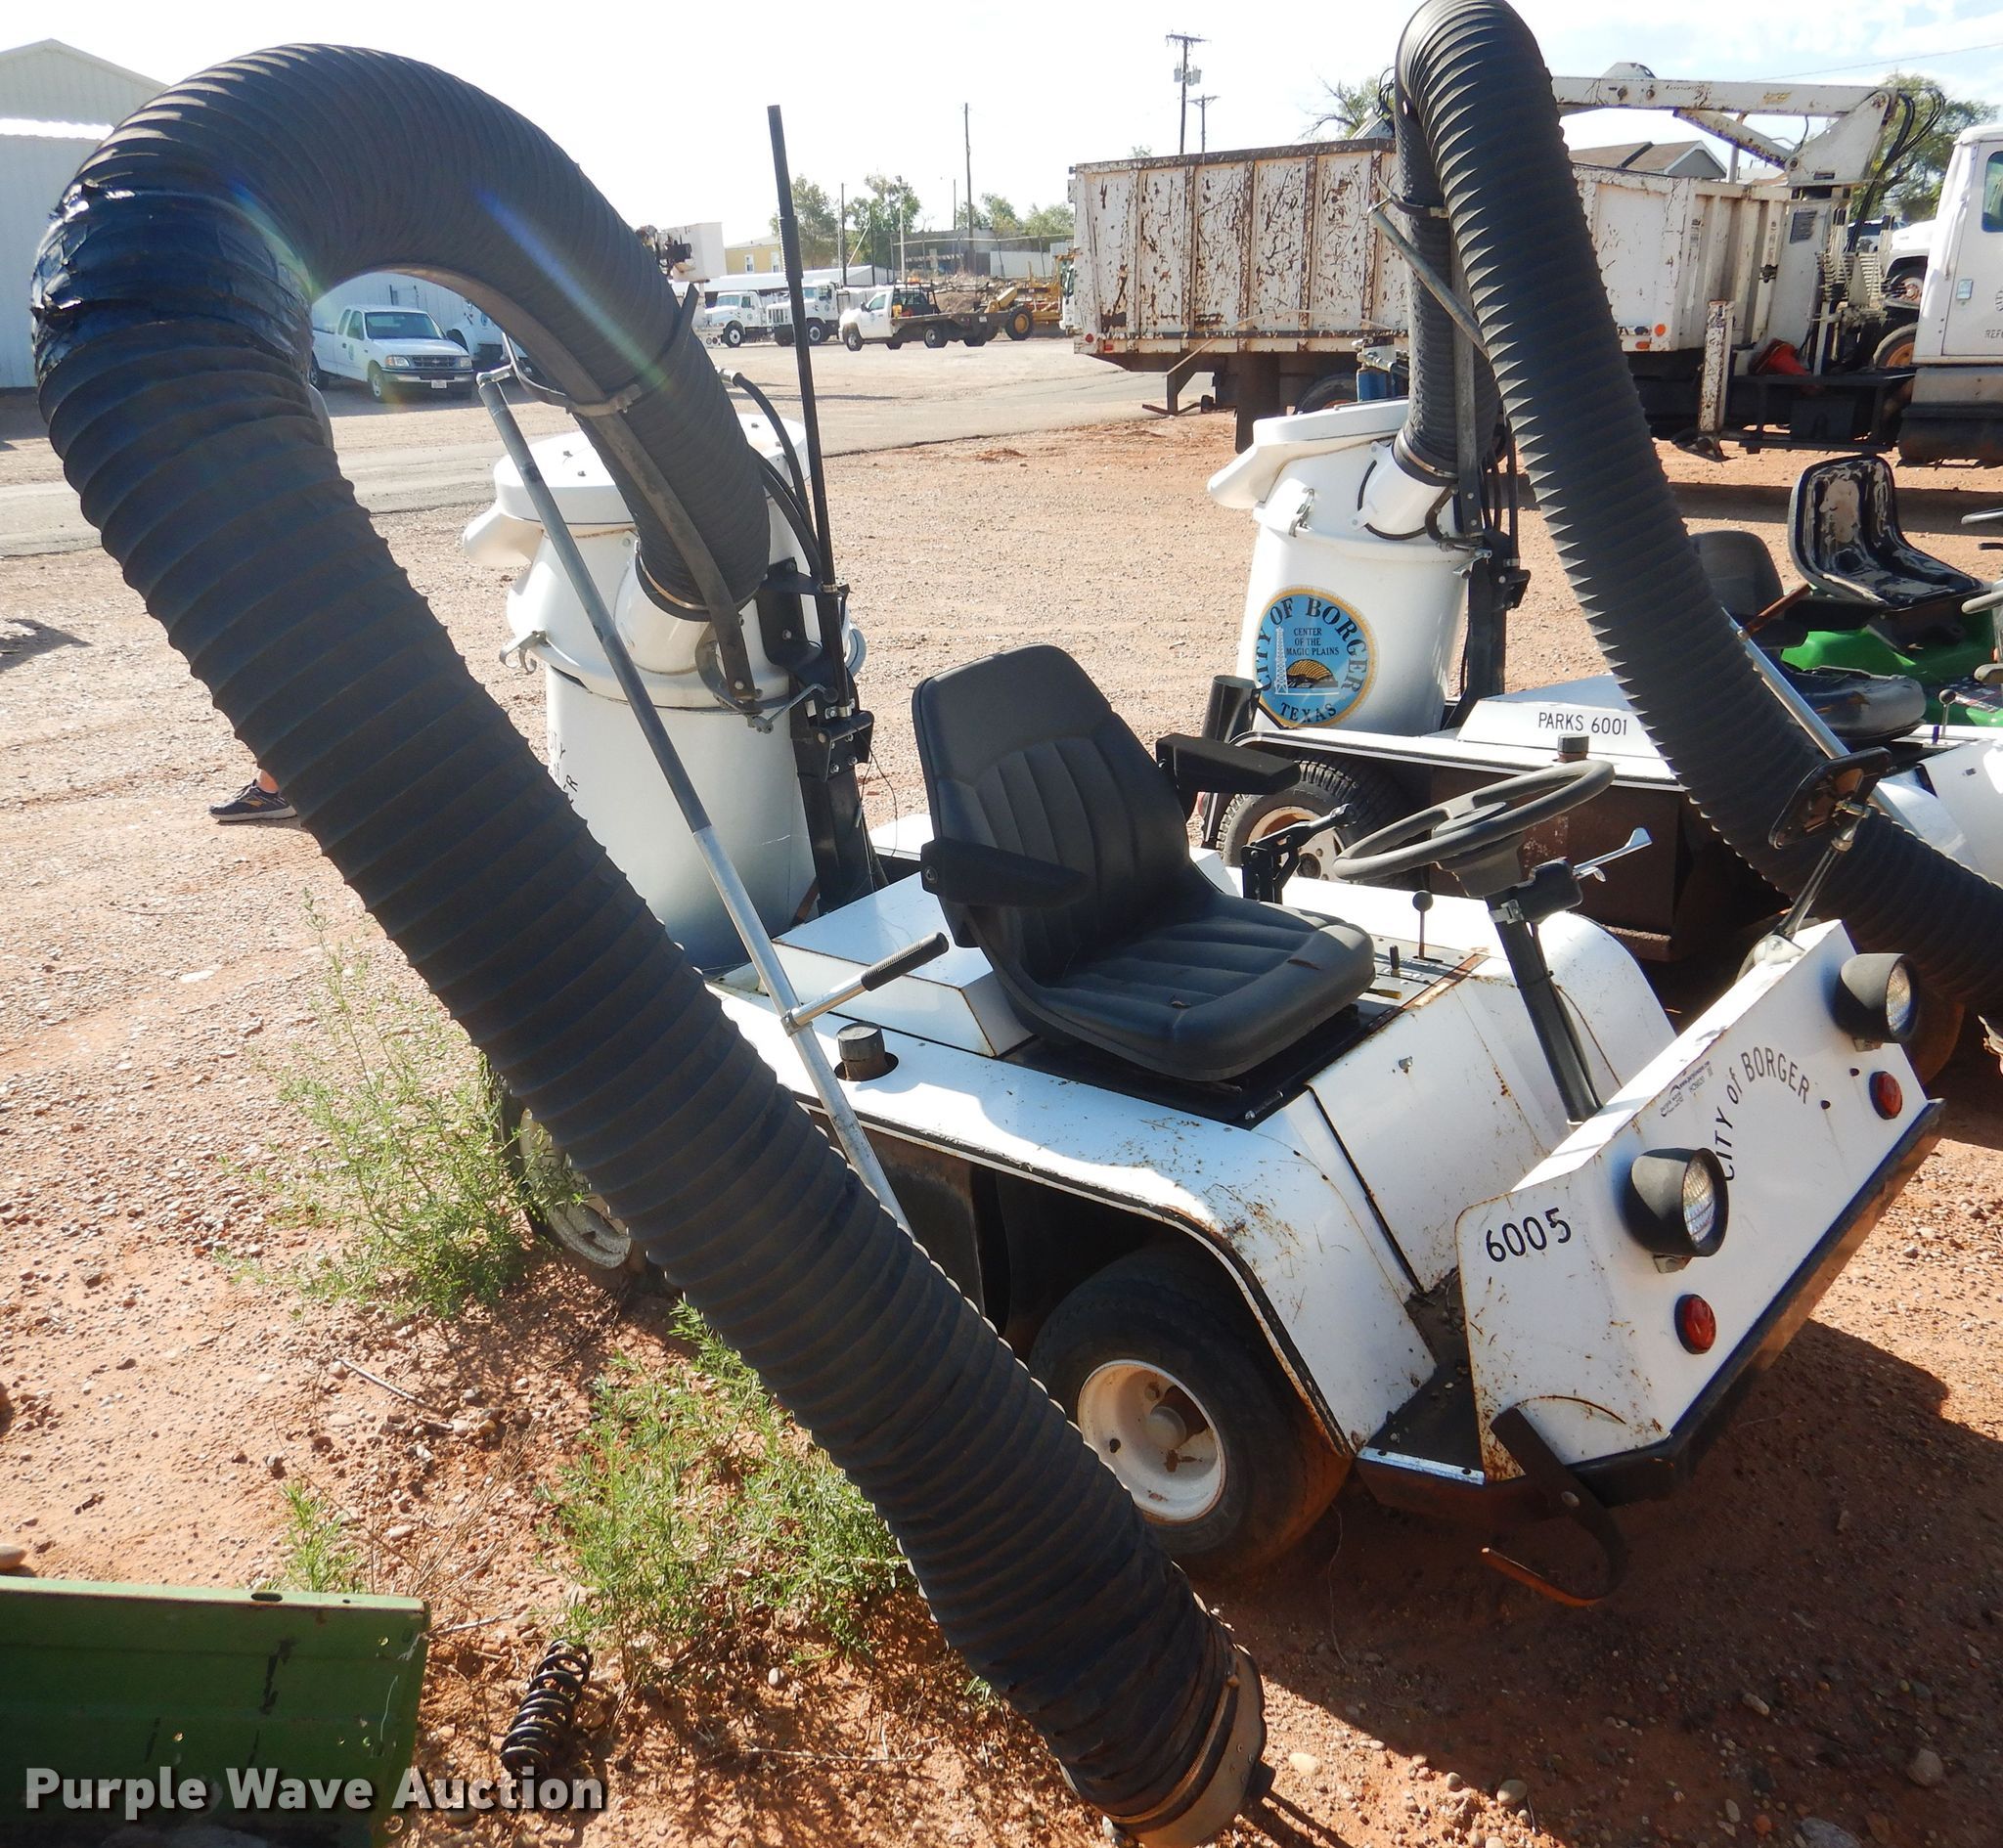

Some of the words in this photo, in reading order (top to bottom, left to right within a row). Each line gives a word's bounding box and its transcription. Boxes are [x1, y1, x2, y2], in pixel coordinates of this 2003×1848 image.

[1293, 627, 1322, 637] CENTER
[1294, 637, 1305, 646] OF
[1306, 637, 1321, 646] THE
[1269, 597, 1294, 626] OF
[1306, 596, 1368, 693] BORGER
[1286, 646, 1310, 656] MAGIC
[1311, 646, 1340, 656] PLAINS
[1280, 702, 1337, 724] TEXAS
[1538, 712, 1584, 731] PARKS
[1590, 717, 1627, 735] 6001
[1714, 1106, 1735, 1181] CITY
[1726, 1067, 1743, 1105] of
[1741, 1046, 1810, 1105] BORGER
[1486, 1207, 1572, 1262] 6005
